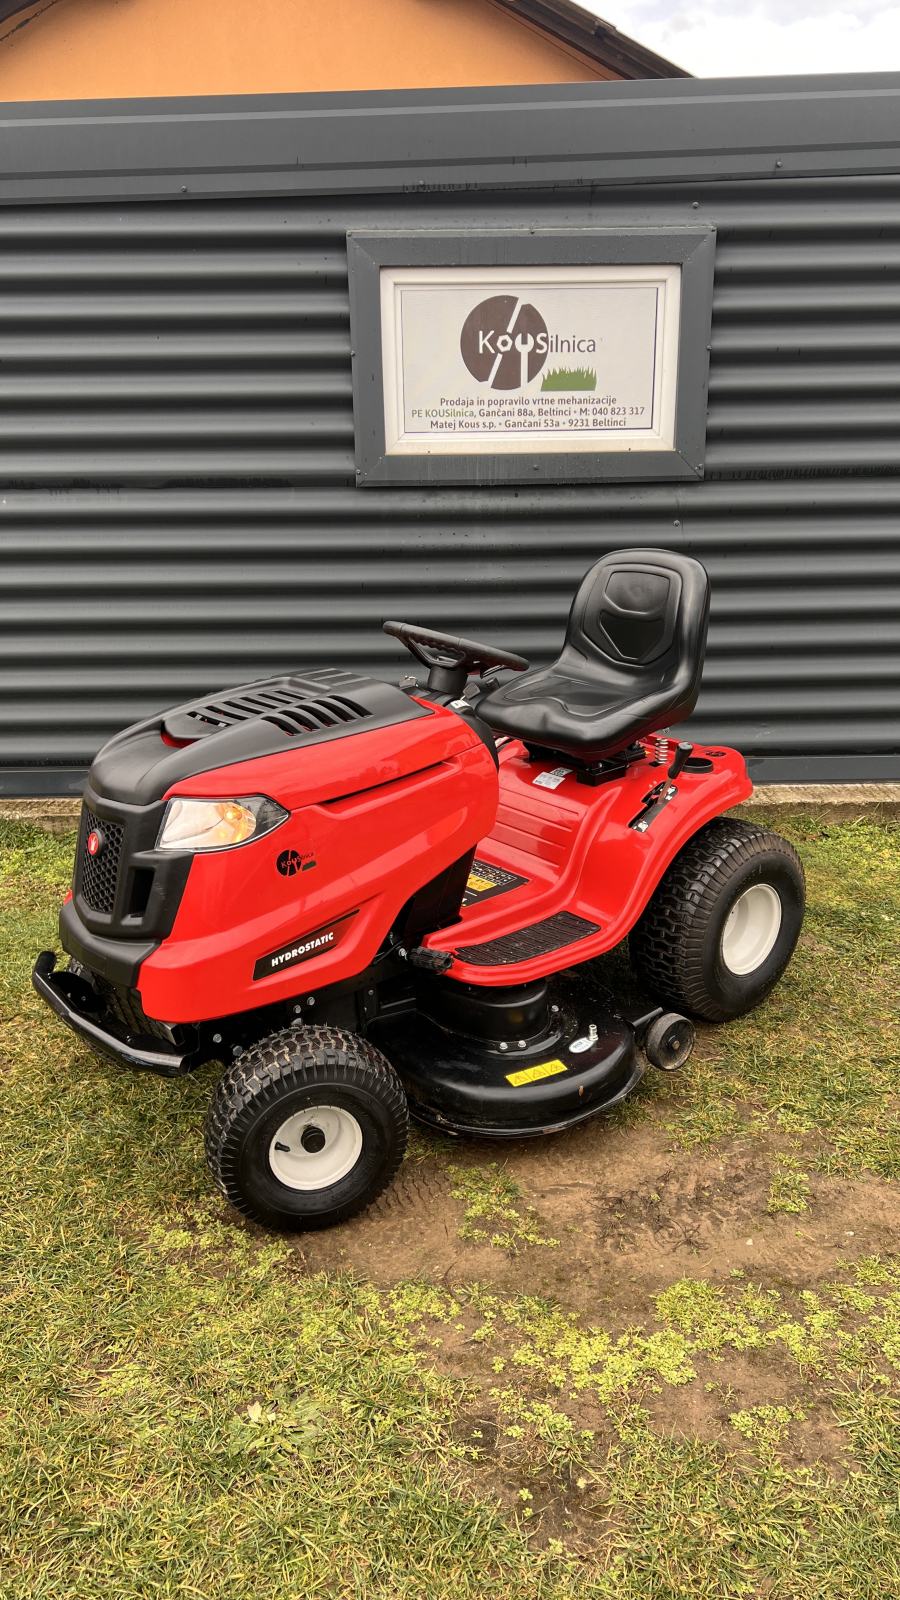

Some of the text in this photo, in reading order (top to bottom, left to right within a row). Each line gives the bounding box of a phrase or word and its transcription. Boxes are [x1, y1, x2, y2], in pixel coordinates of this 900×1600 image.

[440, 397, 475, 407] Prodaja
[476, 398, 485, 406] in
[487, 397, 530, 407] popravilo
[557, 395, 617, 406] mehanizacije
[411, 406, 645, 418] PE KOUSilnica, Gančani 88a, Beltinci M: 040 823 317
[430, 418, 626, 430] Matej Kous s.p. Gančani 53a 9231 Beltinci
[271, 932, 334, 967] HYDROSTATIC
